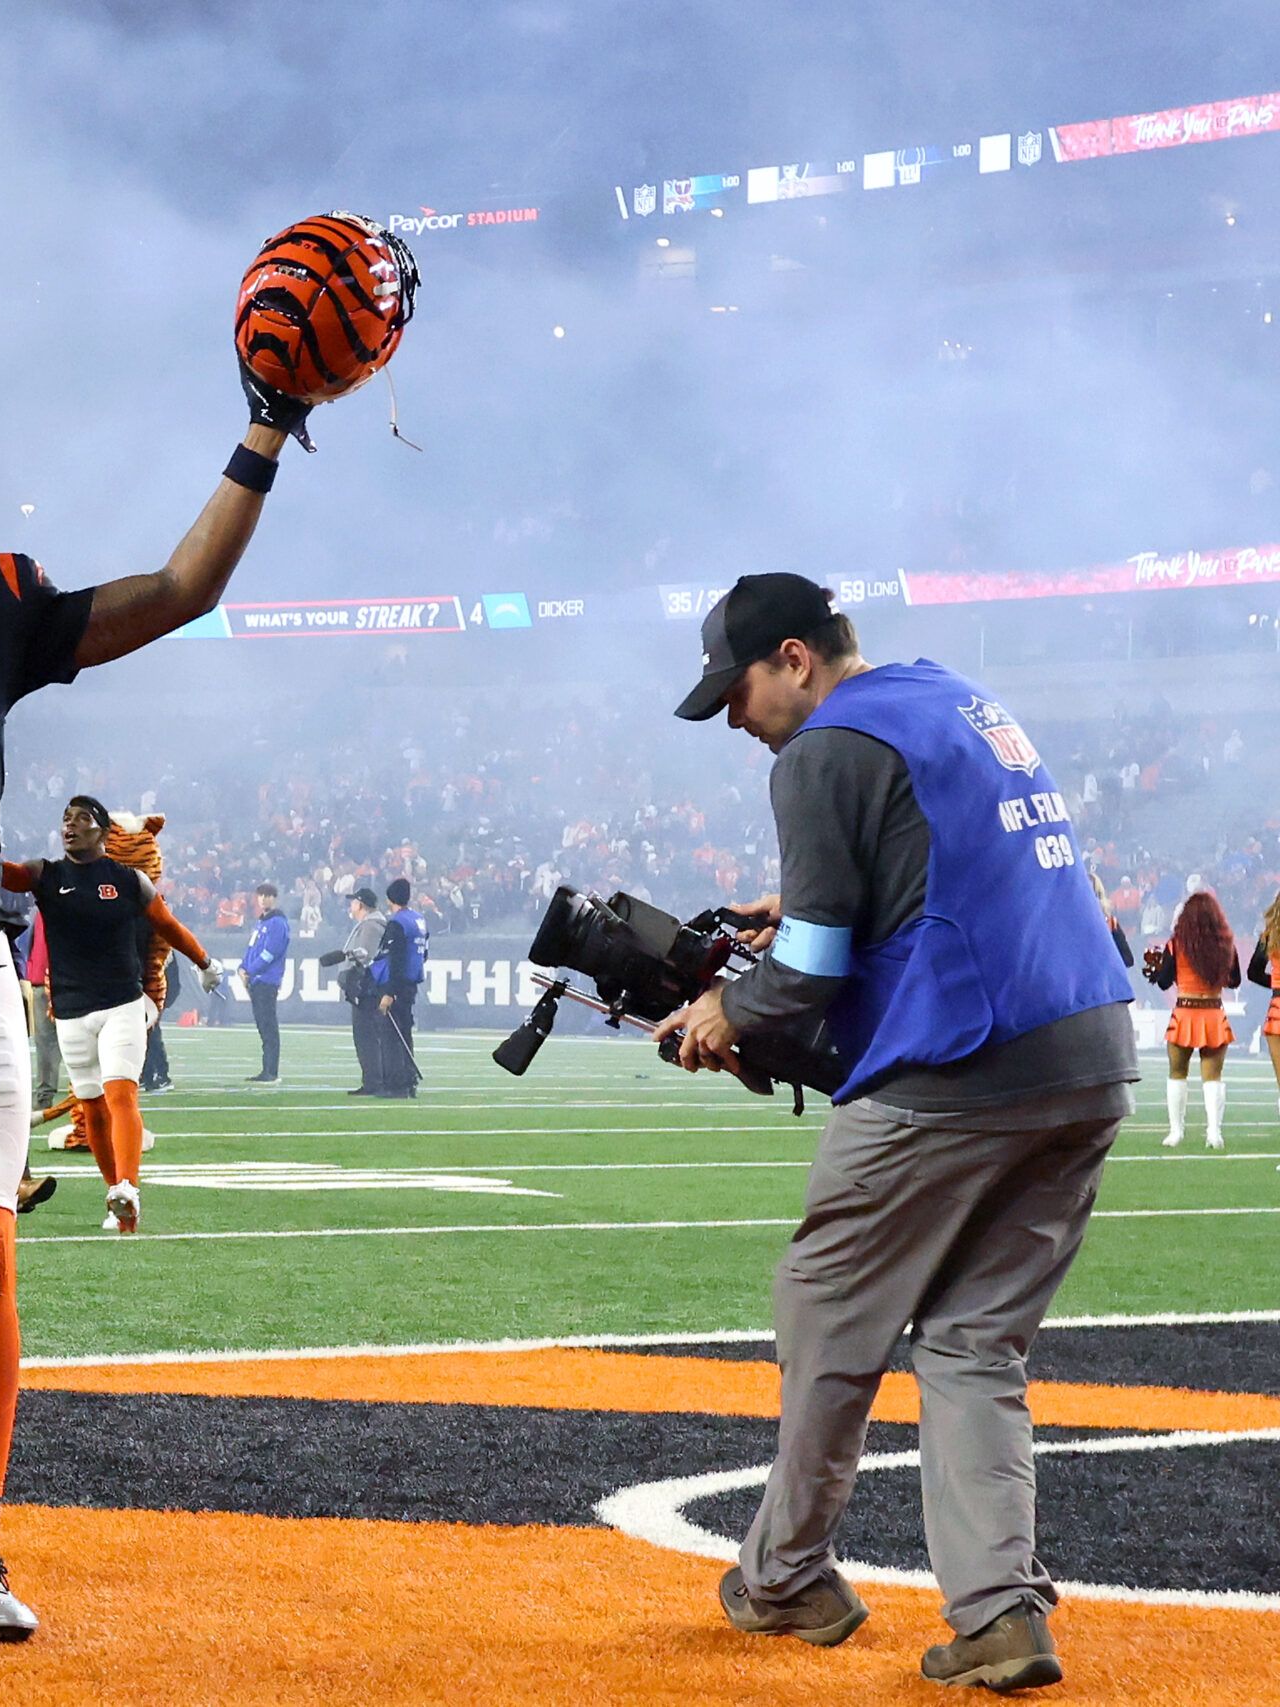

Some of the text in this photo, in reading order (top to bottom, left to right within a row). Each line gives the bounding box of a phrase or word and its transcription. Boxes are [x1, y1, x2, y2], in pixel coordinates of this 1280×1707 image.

[389, 208, 538, 235] Paycor STADIUM
[668, 592, 691, 613] 35
[840, 580, 899, 603] 59 LONG
[245, 612, 302, 628] WHAT'S
[306, 611, 348, 626] YOUR
[470, 600, 584, 625] 4 DICKER
[998, 792, 1071, 832] NFL FILM
[1035, 834, 1075, 870] 039
[424, 959, 558, 1006] THE
